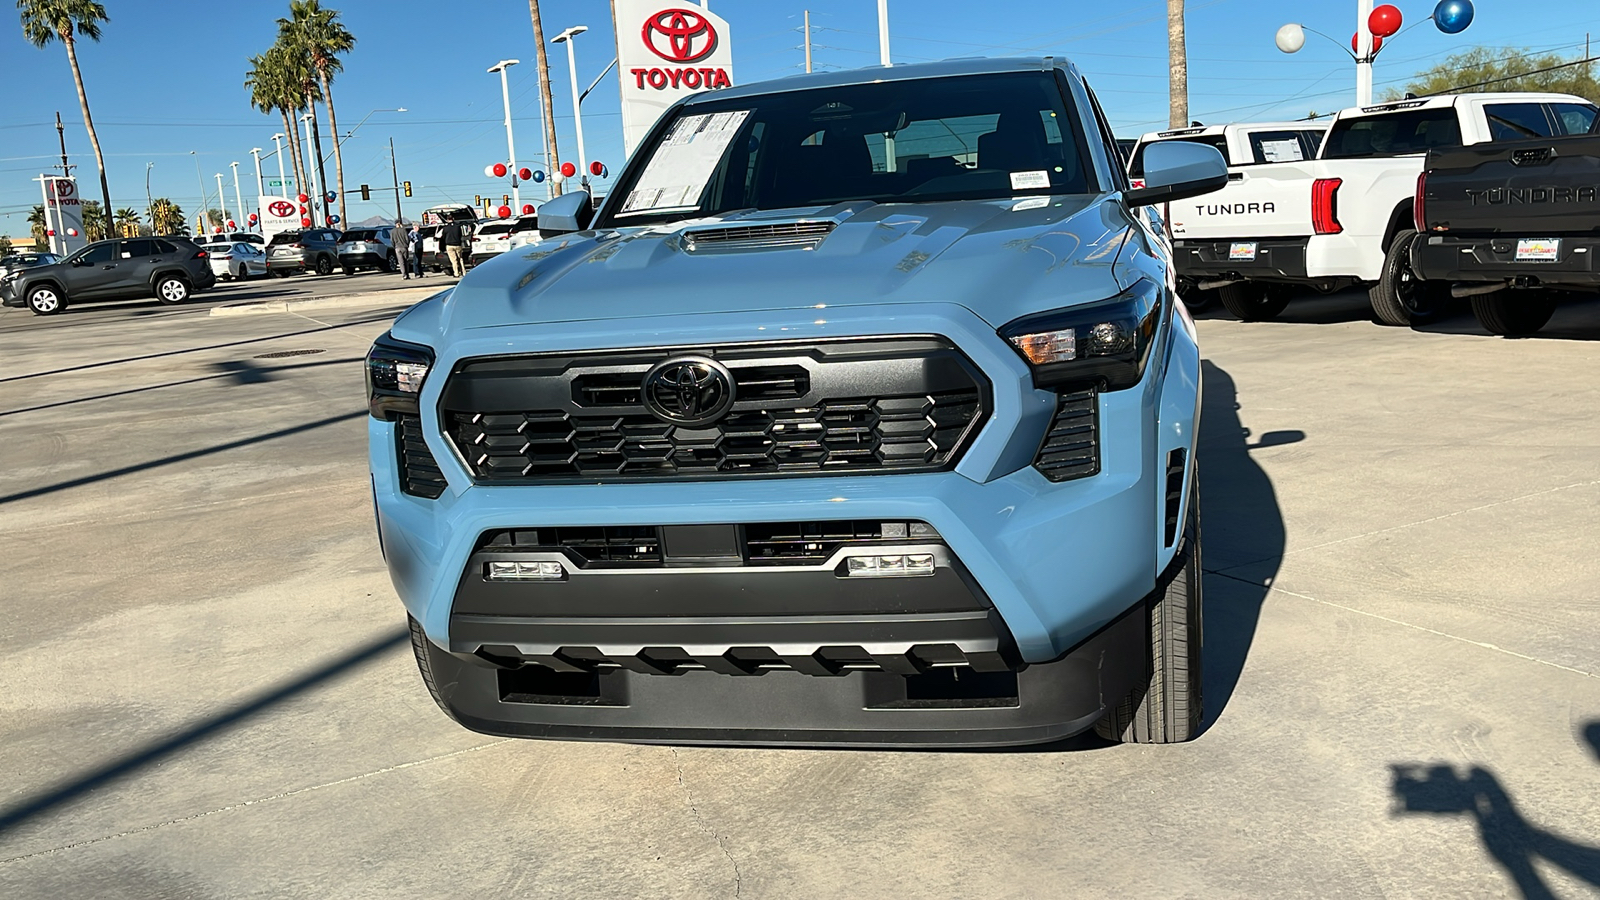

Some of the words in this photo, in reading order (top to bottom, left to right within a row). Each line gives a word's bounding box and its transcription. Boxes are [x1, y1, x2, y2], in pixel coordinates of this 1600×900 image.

[630, 67, 732, 90] TOYOTA
[1465, 186, 1597, 206] TUNDRA
[1195, 202, 1275, 216] TUNDRA
